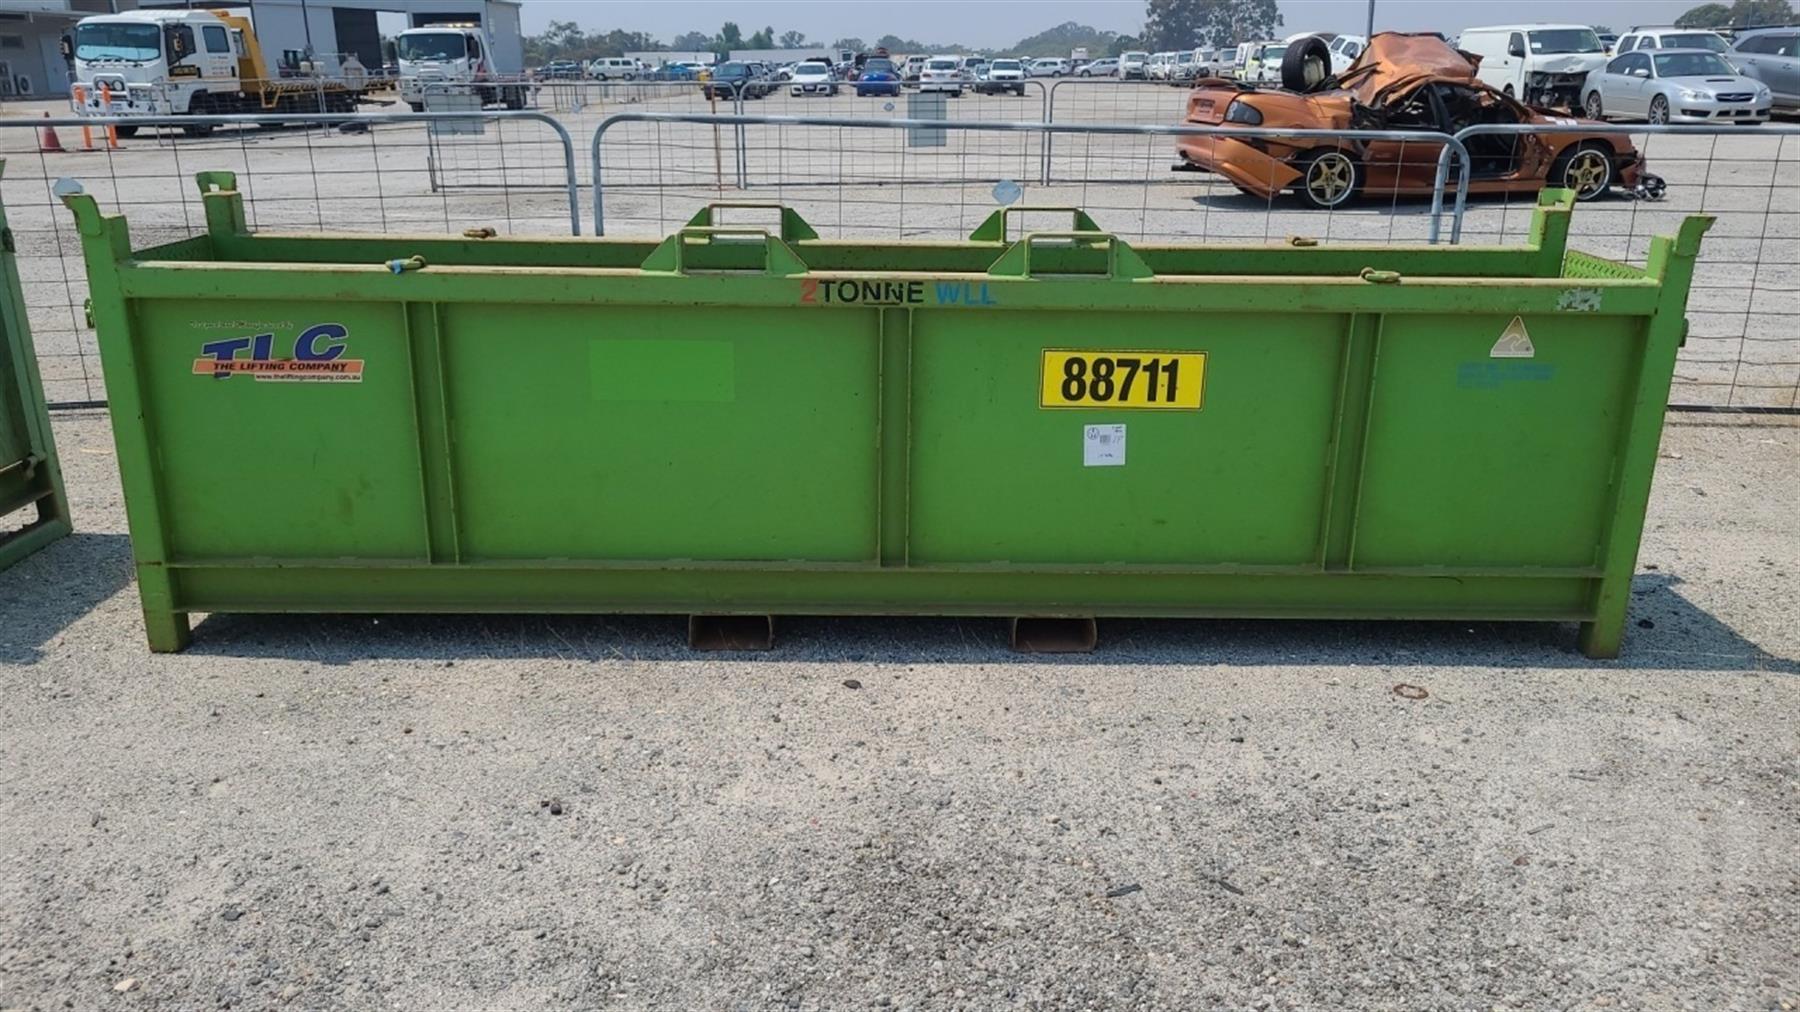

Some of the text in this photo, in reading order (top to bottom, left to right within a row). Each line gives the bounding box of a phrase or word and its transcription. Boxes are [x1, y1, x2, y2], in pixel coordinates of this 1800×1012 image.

[935, 281, 997, 305] WLL
[213, 362, 348, 372] THE LIFTING COMPANY
[1061, 356, 1179, 402] 88711
